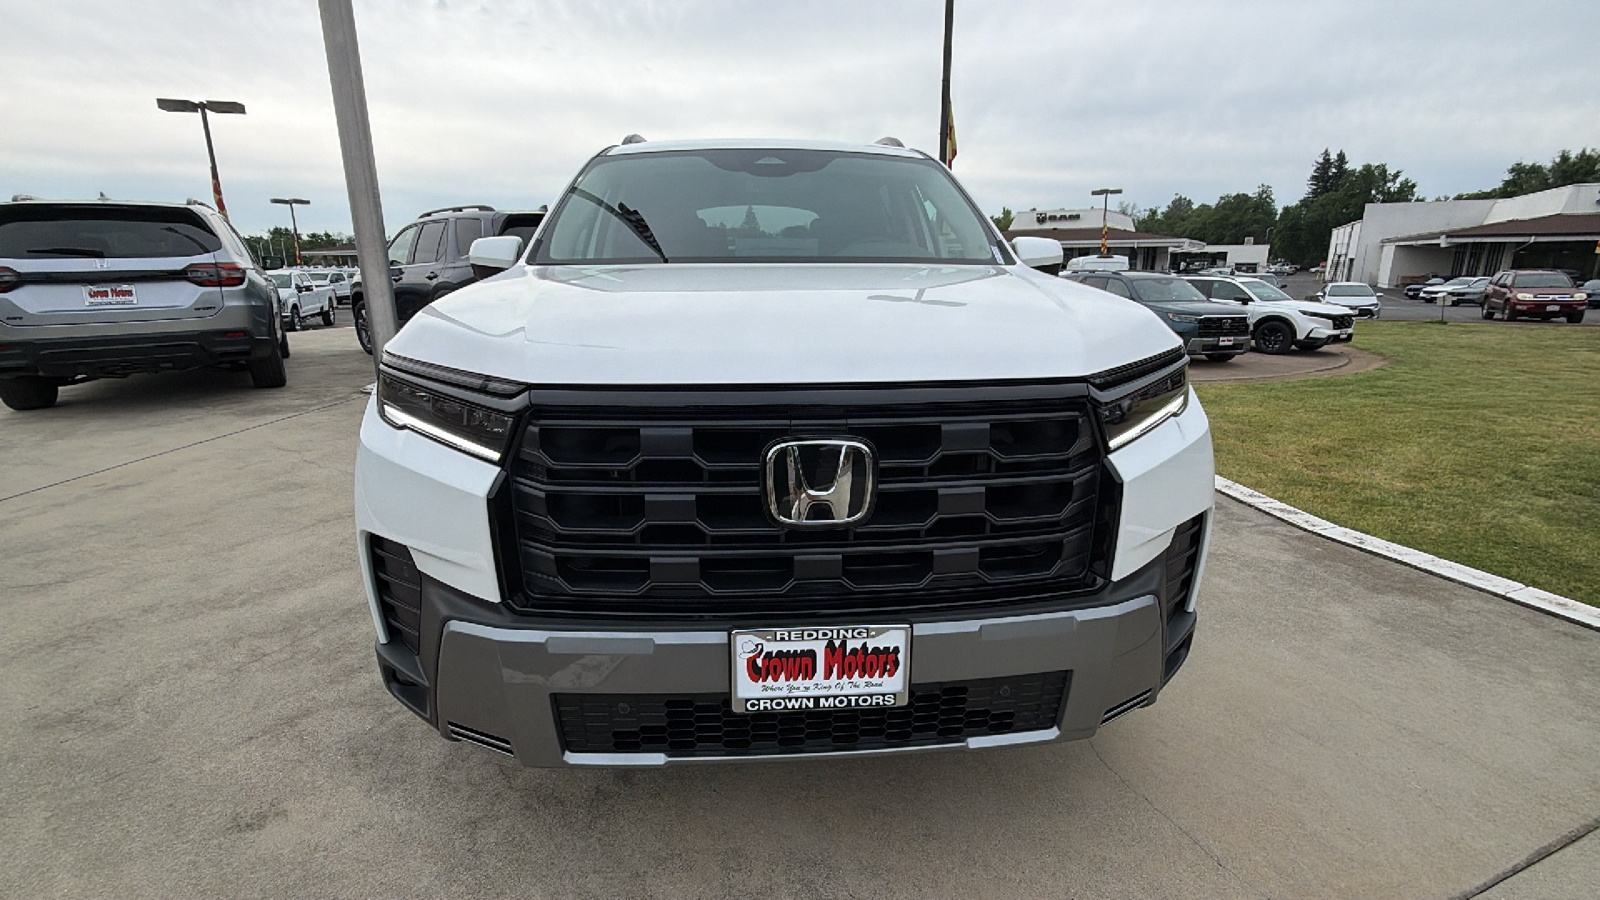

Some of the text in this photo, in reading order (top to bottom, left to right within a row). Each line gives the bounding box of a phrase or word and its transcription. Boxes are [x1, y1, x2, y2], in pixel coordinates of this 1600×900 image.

[775, 628, 868, 641] REDDING
[746, 640, 900, 683] Crown Motors
[761, 684, 784, 692] Where
[813, 682, 832, 692] King
[834, 682, 845, 692] Of
[847, 681, 860, 689] The
[863, 681, 884, 689] Road
[746, 695, 895, 711] CROWN MOTORS
